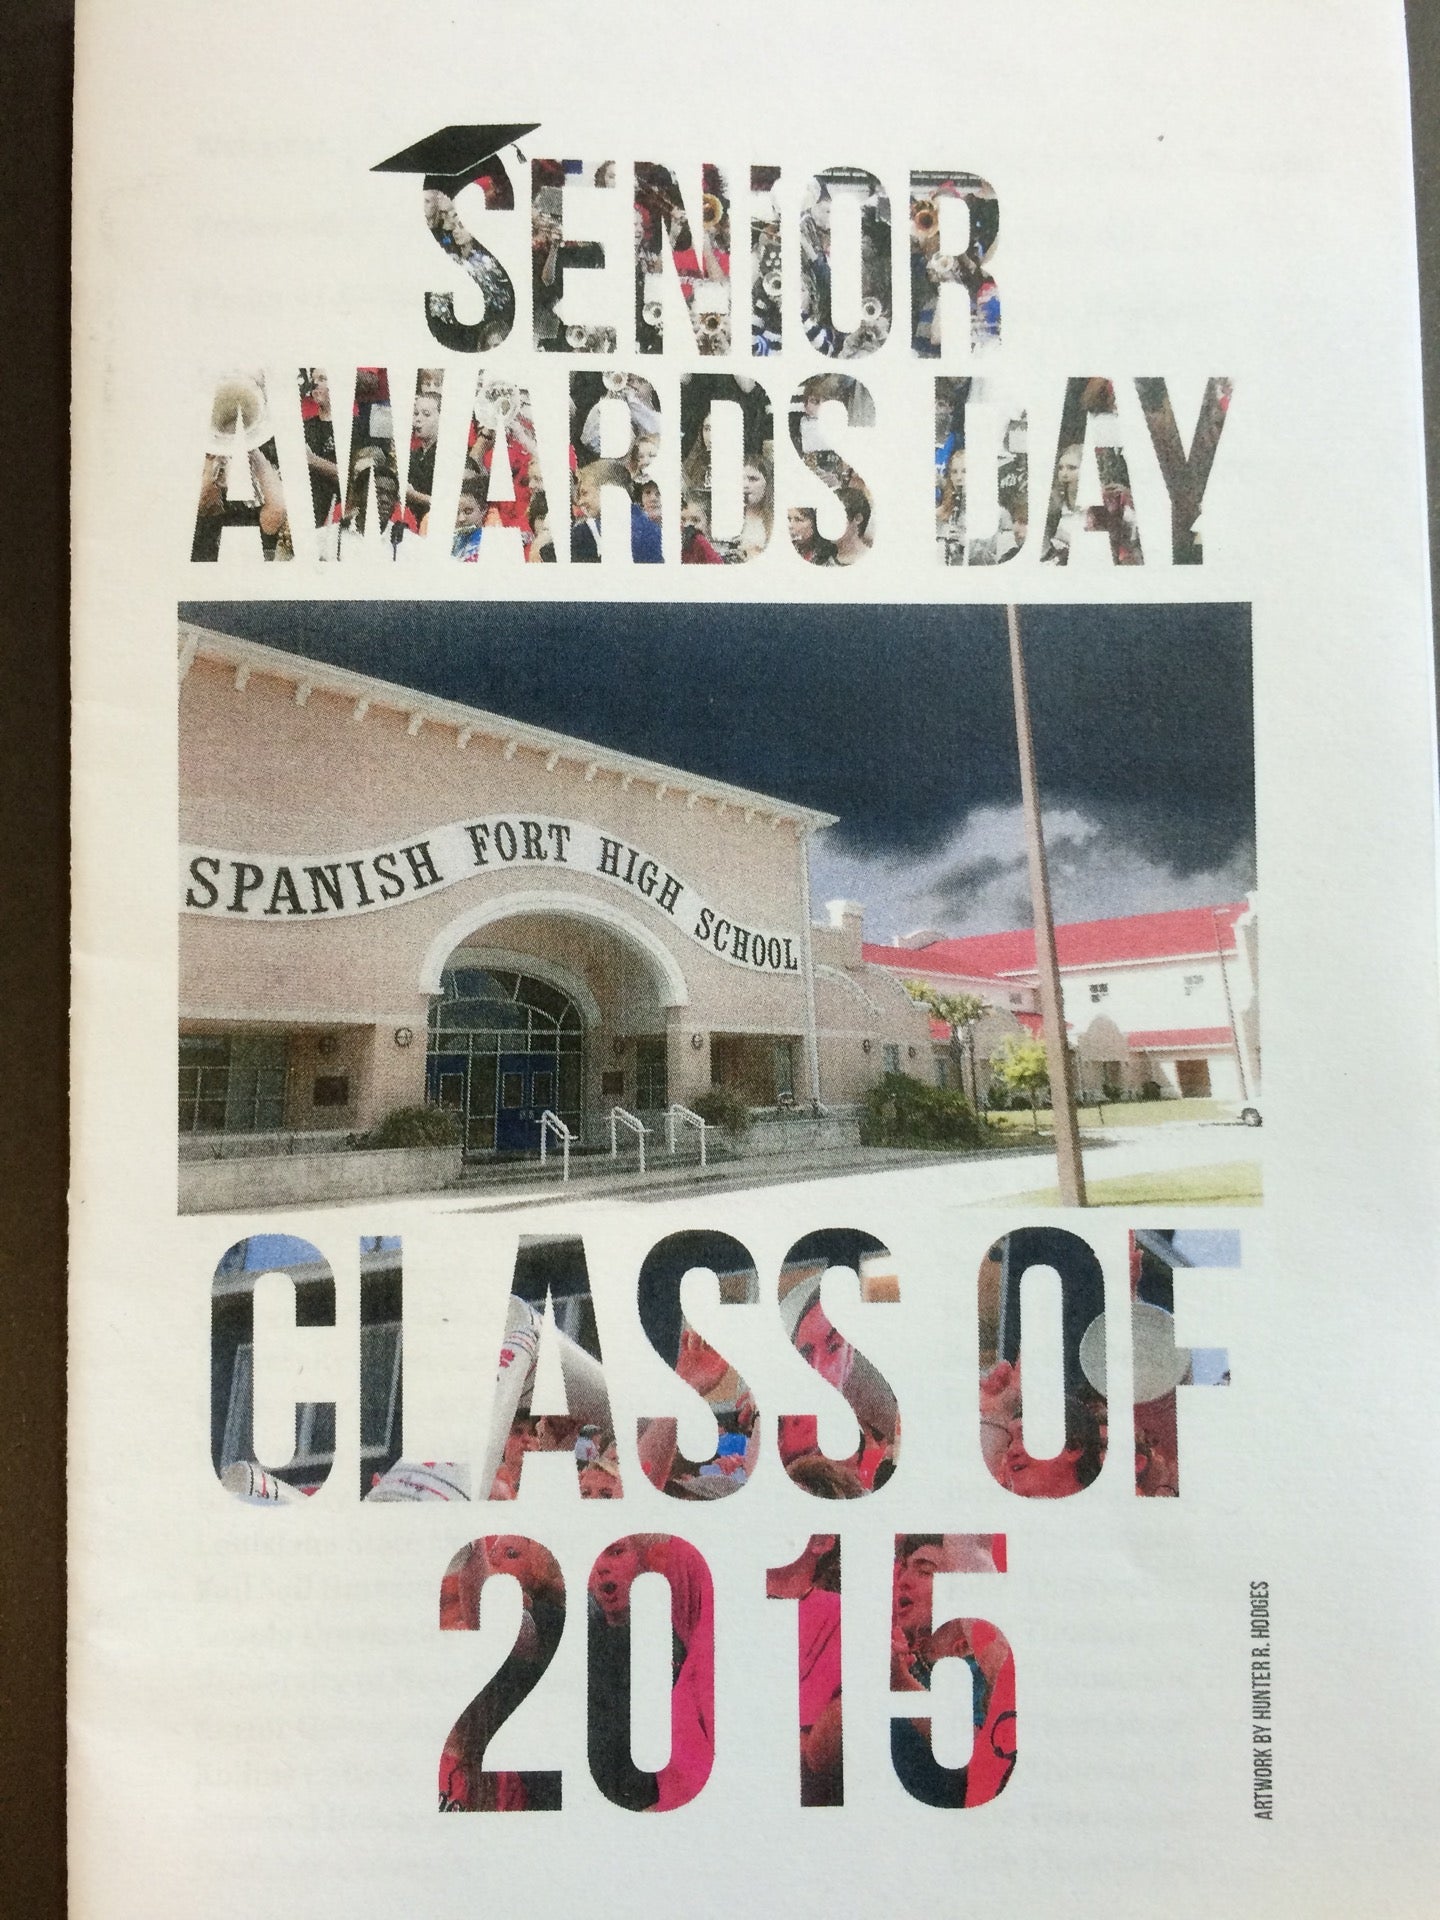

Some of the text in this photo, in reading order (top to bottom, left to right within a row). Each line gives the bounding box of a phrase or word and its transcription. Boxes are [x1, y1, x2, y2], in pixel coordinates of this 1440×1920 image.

[422, 153, 1002, 360] SENIOR
[191, 366, 1235, 567] AWARDS DAY
[185, 820, 798, 971] SPANISH FORT HIGH SCHOOL
[210, 1226, 1241, 1503] CLASS OF
[438, 1533, 1018, 1813] 2015
[1250, 1580, 1273, 1821] ARTWORK BY HUNTER R. HODGES
